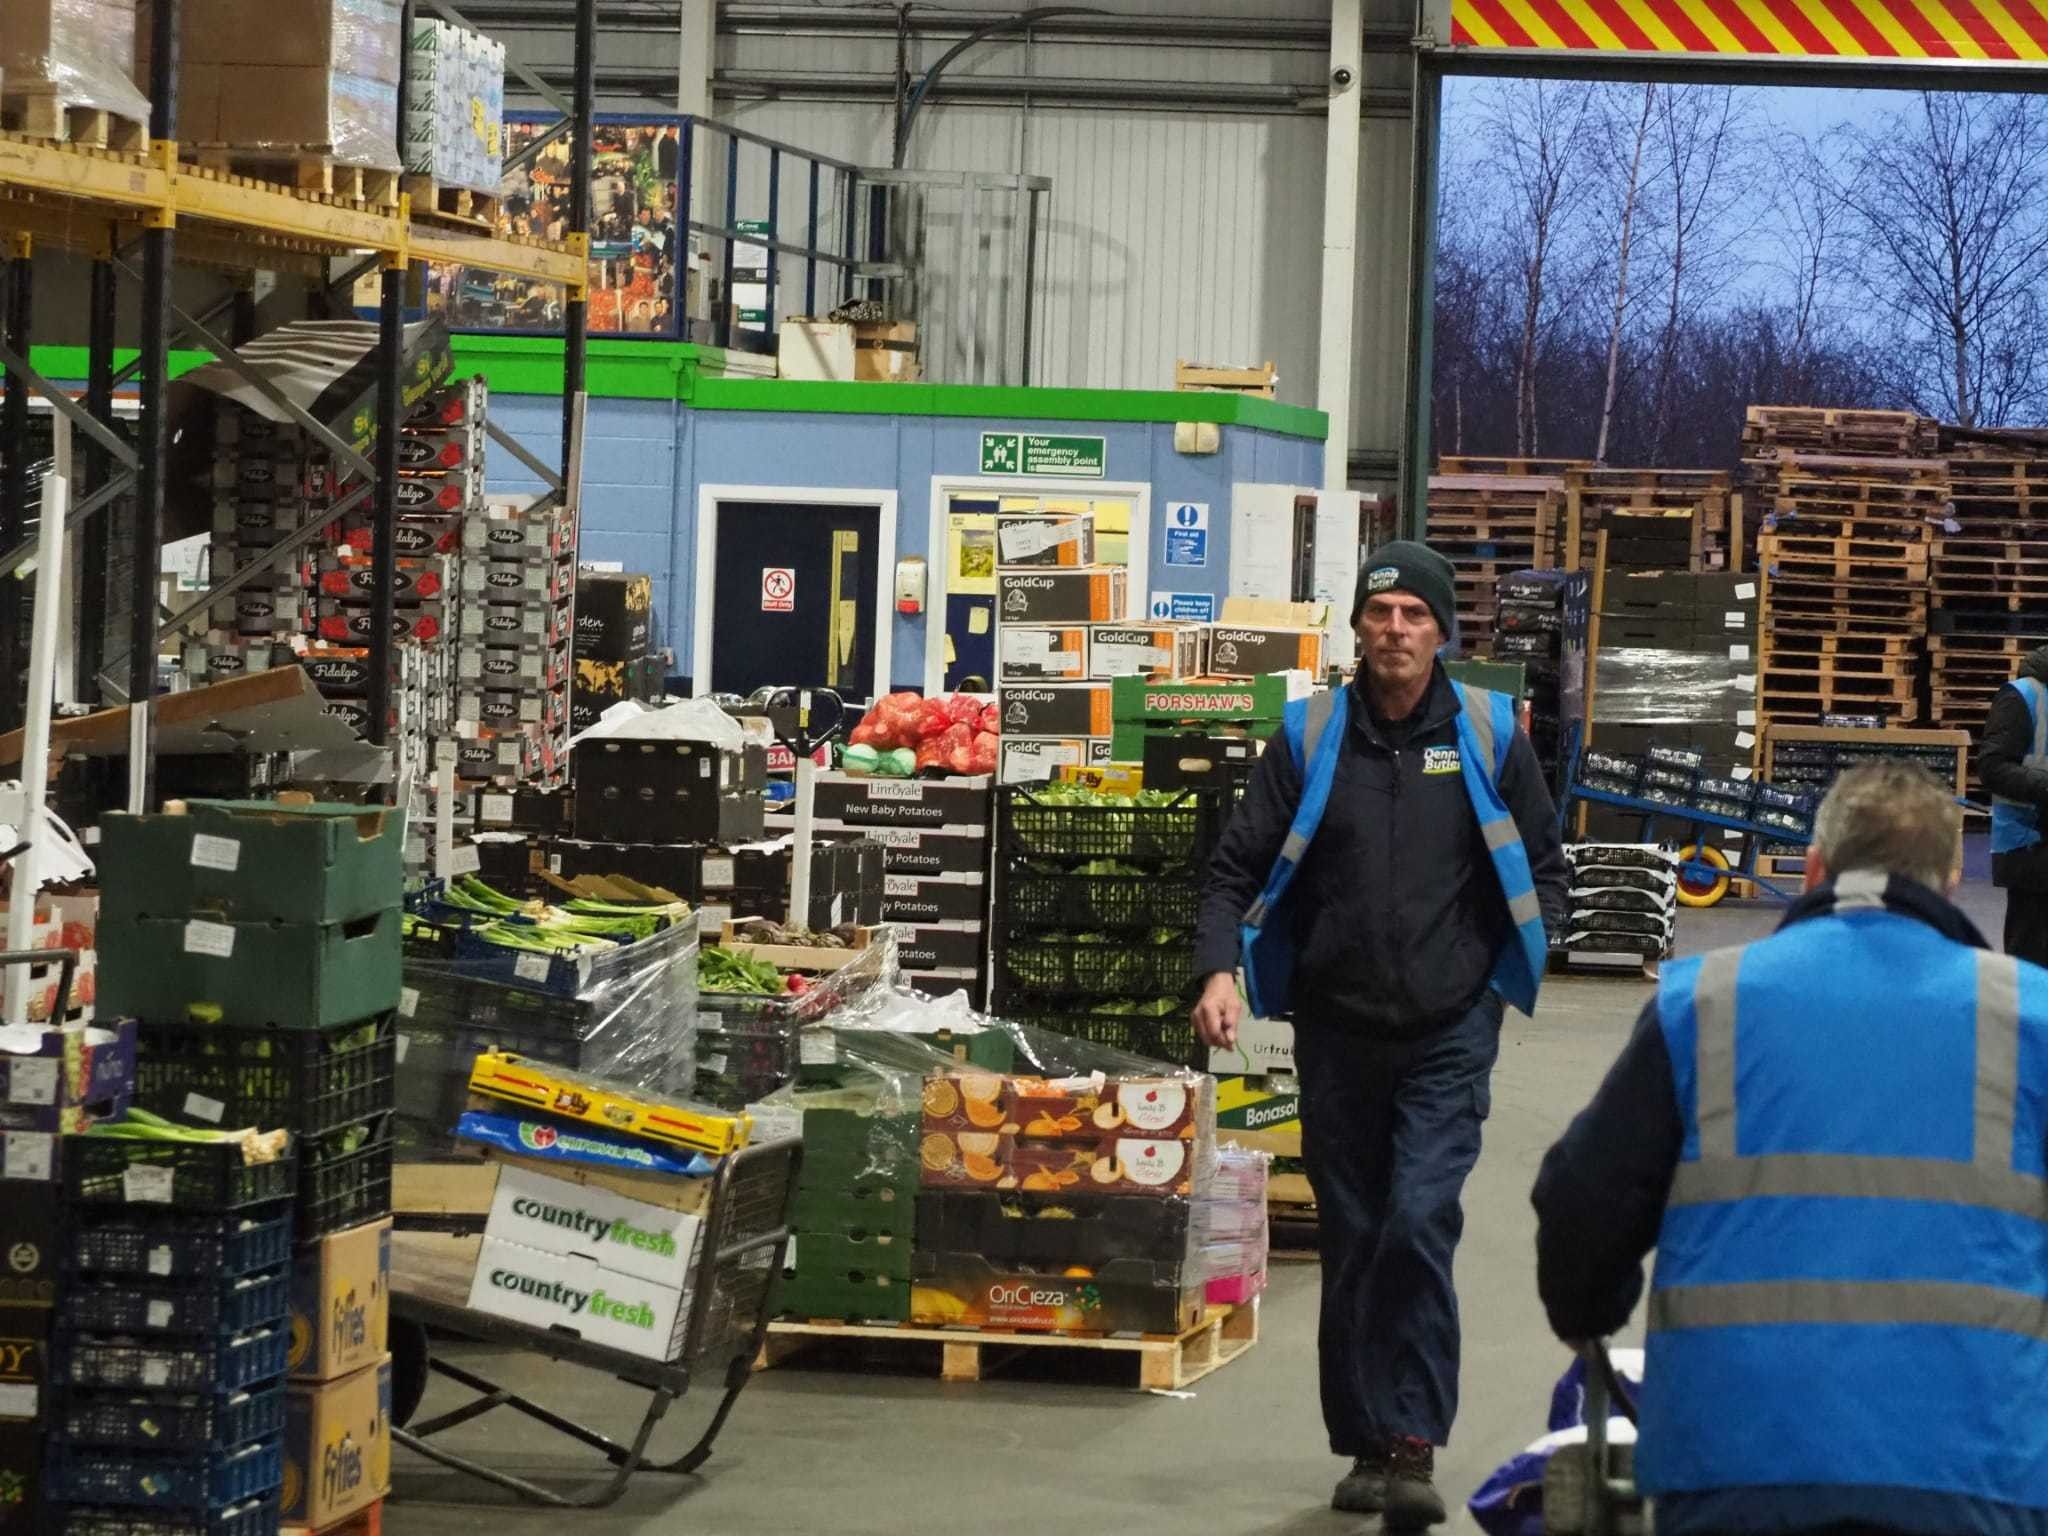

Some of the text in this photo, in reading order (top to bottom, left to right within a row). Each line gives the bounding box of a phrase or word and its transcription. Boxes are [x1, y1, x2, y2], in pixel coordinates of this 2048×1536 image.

[1028, 437, 1050, 446] Your
[1027, 447, 1079, 456] emergency
[1027, 456, 1098, 466] assembly point
[1003, 576, 1055, 589] GoldCup
[1098, 632, 1149, 644] GoldCup
[1216, 630, 1266, 645] GoldCup
[315, 661, 359, 683] Fidalgo
[1005, 690, 1056, 702] GoldCup
[1145, 693, 1254, 711] FORSHAW'S
[1004, 742, 1041, 753] GoldC
[846, 804, 943, 817] New Baby Potatoes
[896, 853, 941, 865] Potatoes
[894, 901, 939, 912] Potatoes
[898, 950, 937, 960] otatoes
[1246, 1097, 1299, 1127] Bonasol
